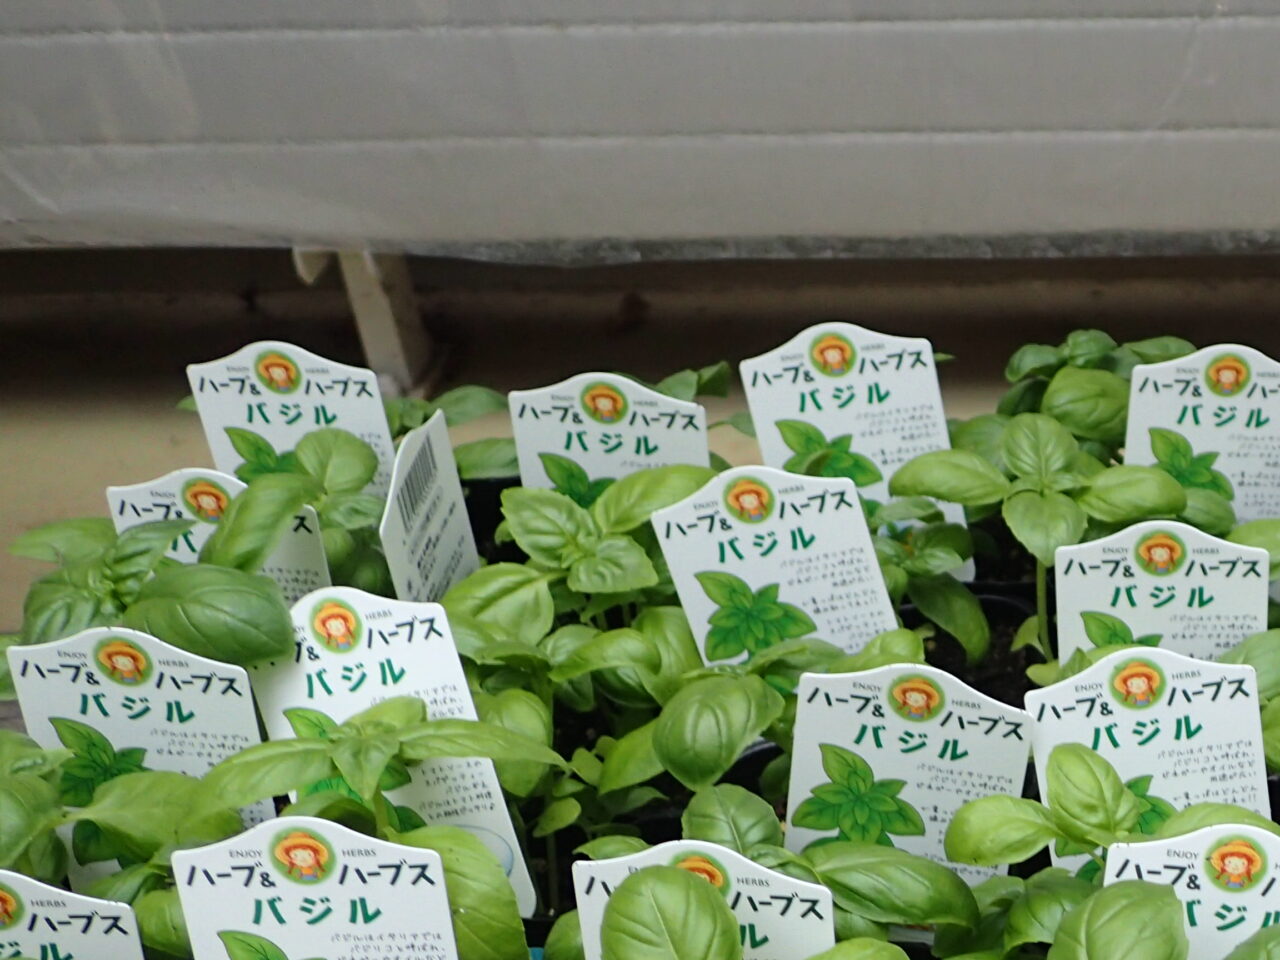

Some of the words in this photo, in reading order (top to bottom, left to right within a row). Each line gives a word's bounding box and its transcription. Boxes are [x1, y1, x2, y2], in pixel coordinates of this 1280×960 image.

[859, 348, 928, 374] ハーブス
[304, 378, 373, 398] ハーブス
[800, 383, 890, 413] バジル
[246, 403, 338, 425] バジル
[629, 410, 699, 431] ハーブス
[1177, 405, 1270, 428] バジル
[564, 431, 659, 455] バジル
[779, 489, 853, 519] ハーブス
[718, 527, 816, 563] バジル
[1185, 556, 1262, 578] ハーブス
[1110, 584, 1214, 608] バジル
[366, 615, 444, 649] ハーブス
[57, 650, 88, 660] ENJOY
[158, 658, 189, 668] HERBS
[155, 671, 243, 697] ハーブス
[306, 658, 406, 699] バジル
[1074, 682, 1104, 693] ENJOY
[1171, 670, 1202, 680] HERBS
[1167, 676, 1250, 706] ハーブス
[80, 693, 195, 724] バジル
[852, 681, 882, 692] ENJOY
[951, 700, 982, 710] HERBS
[940, 711, 1024, 741] ハーブス
[1092, 715, 1203, 751] バジル
[854, 724, 969, 761] バジル
[229, 850, 263, 858] ENJOY
[1166, 849, 1199, 860] ENJOY
[338, 859, 436, 886] ハーブス
[736, 876, 770, 888] HERBS
[31, 899, 67, 907] HERBS
[252, 896, 382, 925] バジル
[731, 891, 824, 920] ハーブス
[27, 911, 128, 935] ハーブス
